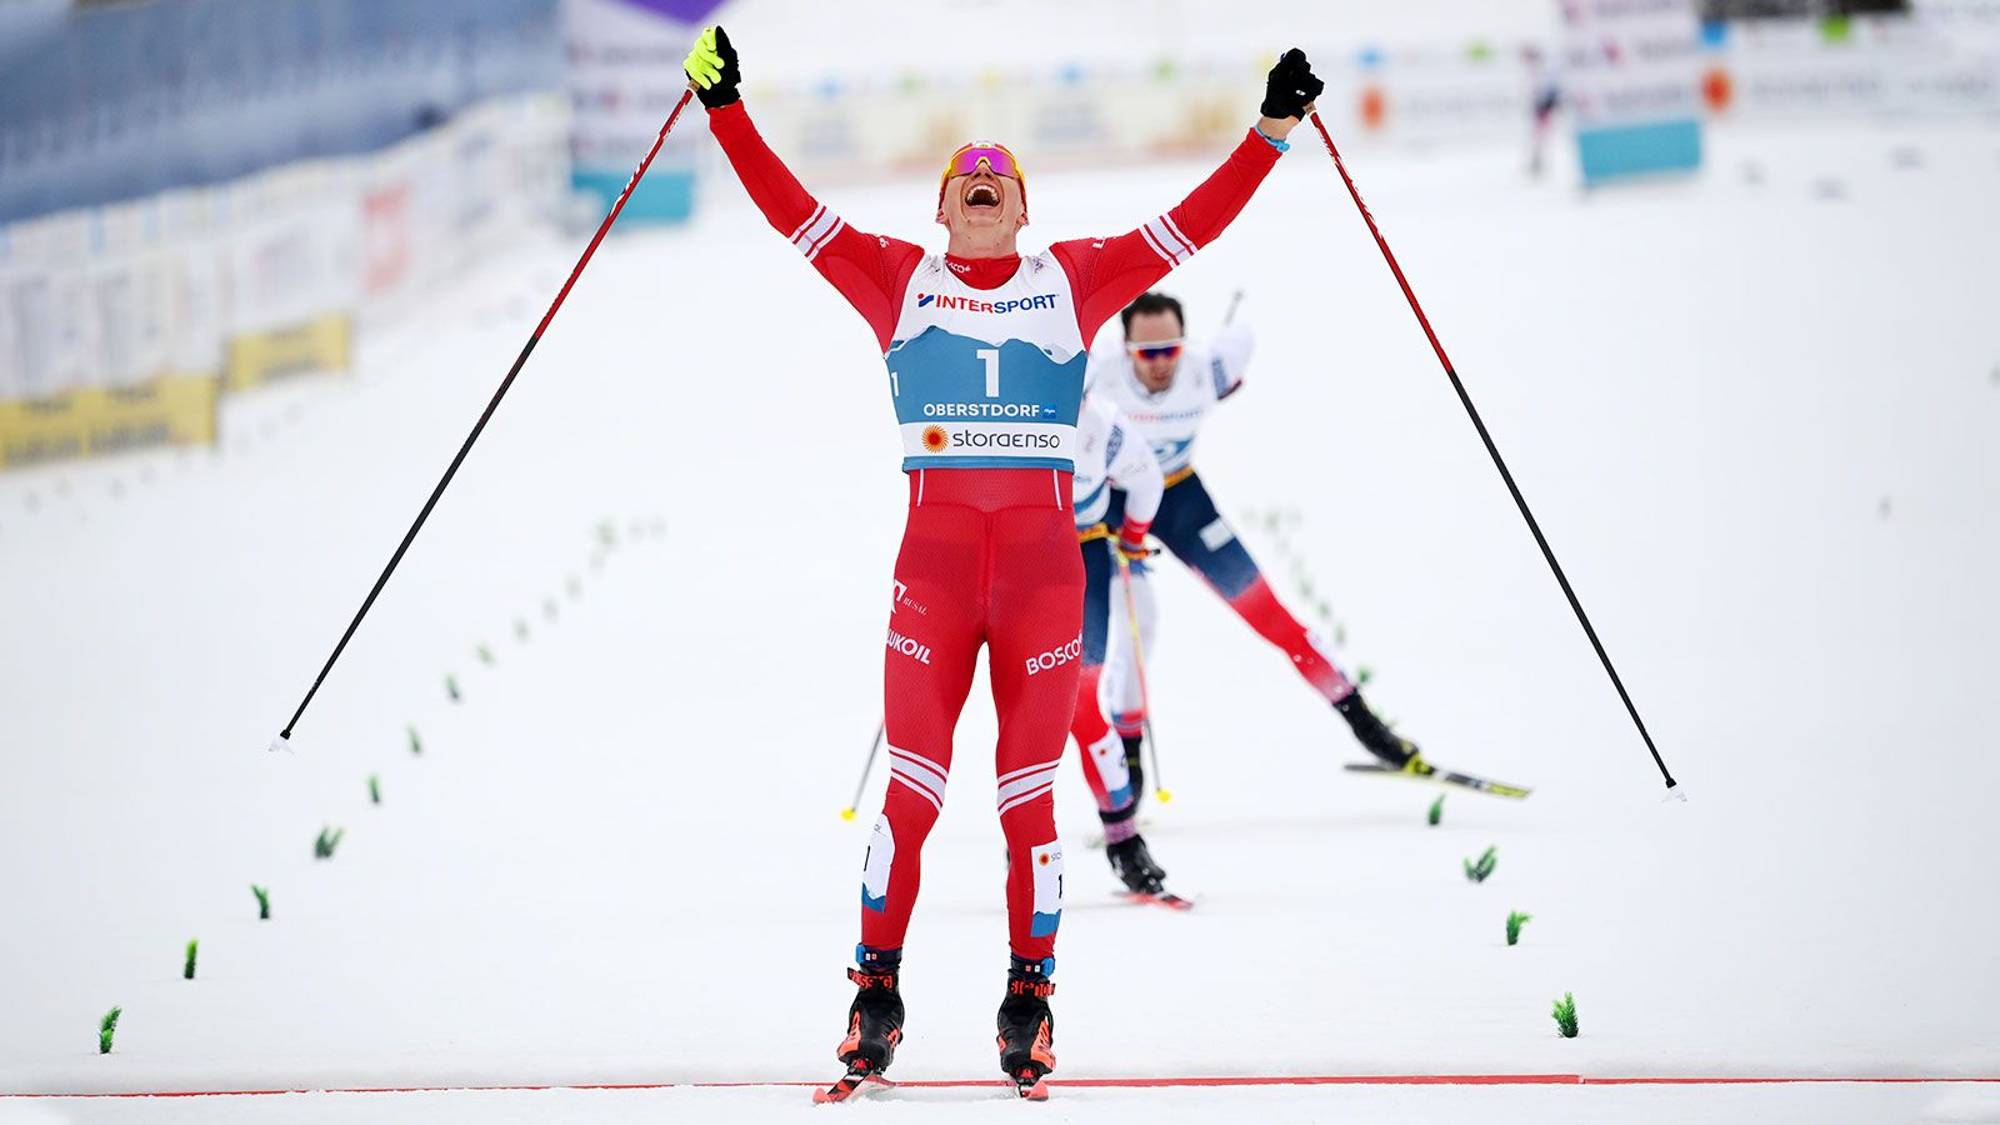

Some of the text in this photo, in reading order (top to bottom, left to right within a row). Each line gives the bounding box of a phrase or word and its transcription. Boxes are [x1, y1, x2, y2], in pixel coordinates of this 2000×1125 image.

[936, 294, 1057, 314] INTERSPORT
[891, 371, 899, 397] 1
[976, 349, 1000, 398] 1
[923, 403, 1040, 417] OBERSTDORF
[887, 629, 931, 665] UKOIL
